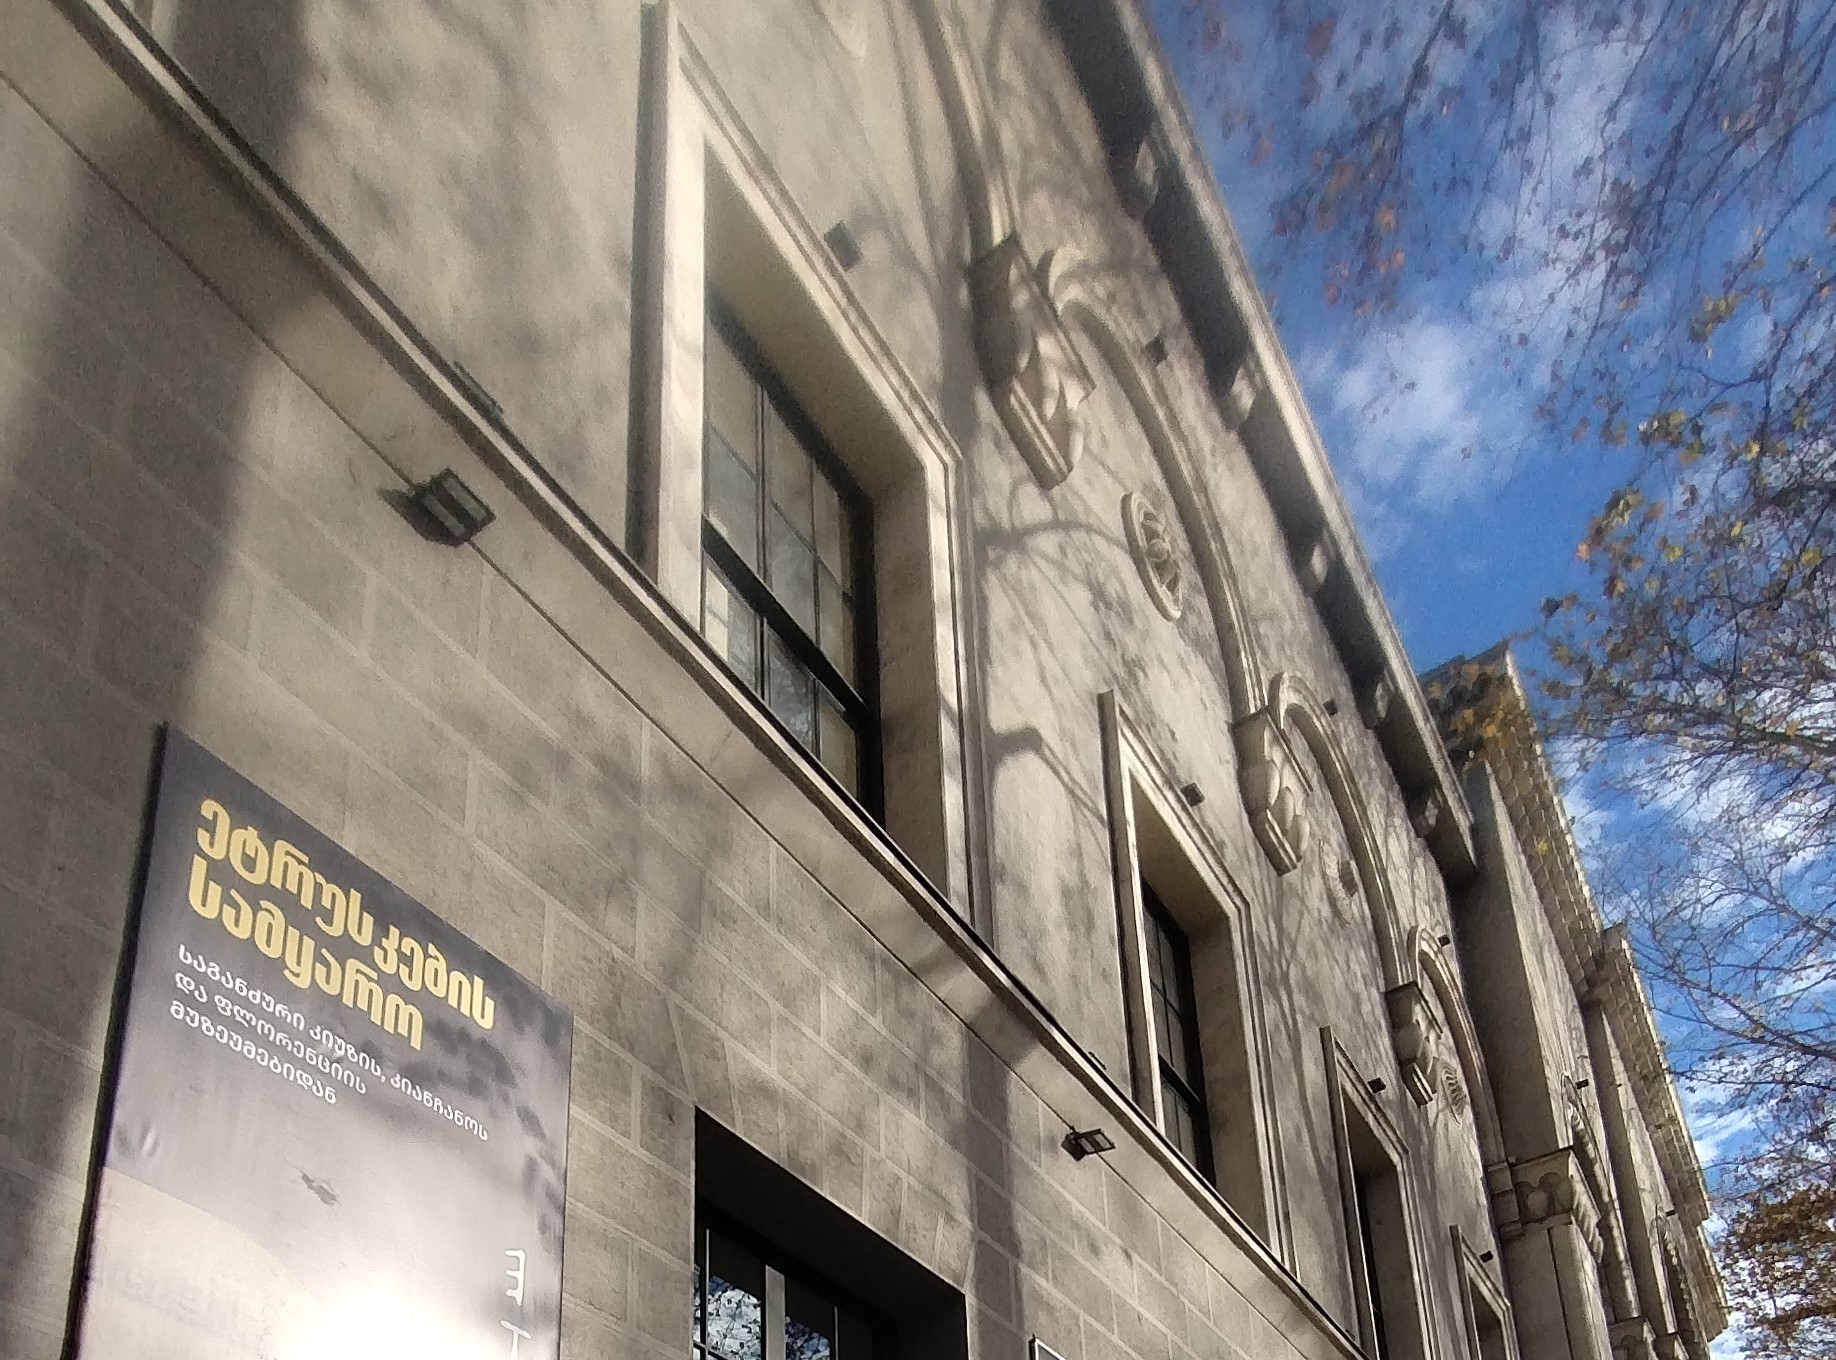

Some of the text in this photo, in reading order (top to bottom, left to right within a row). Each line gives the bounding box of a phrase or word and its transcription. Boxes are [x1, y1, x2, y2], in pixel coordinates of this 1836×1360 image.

[188, 854, 424, 1052] სამყარო
[196, 798, 496, 1030] ეტრუსკების
[170, 1000, 336, 1104] მუზეუმებიდან
[175, 972, 367, 1094] და ფლორენციის
[178, 943, 488, 1141] საგანძური კიუზის, კიანჩანოს
